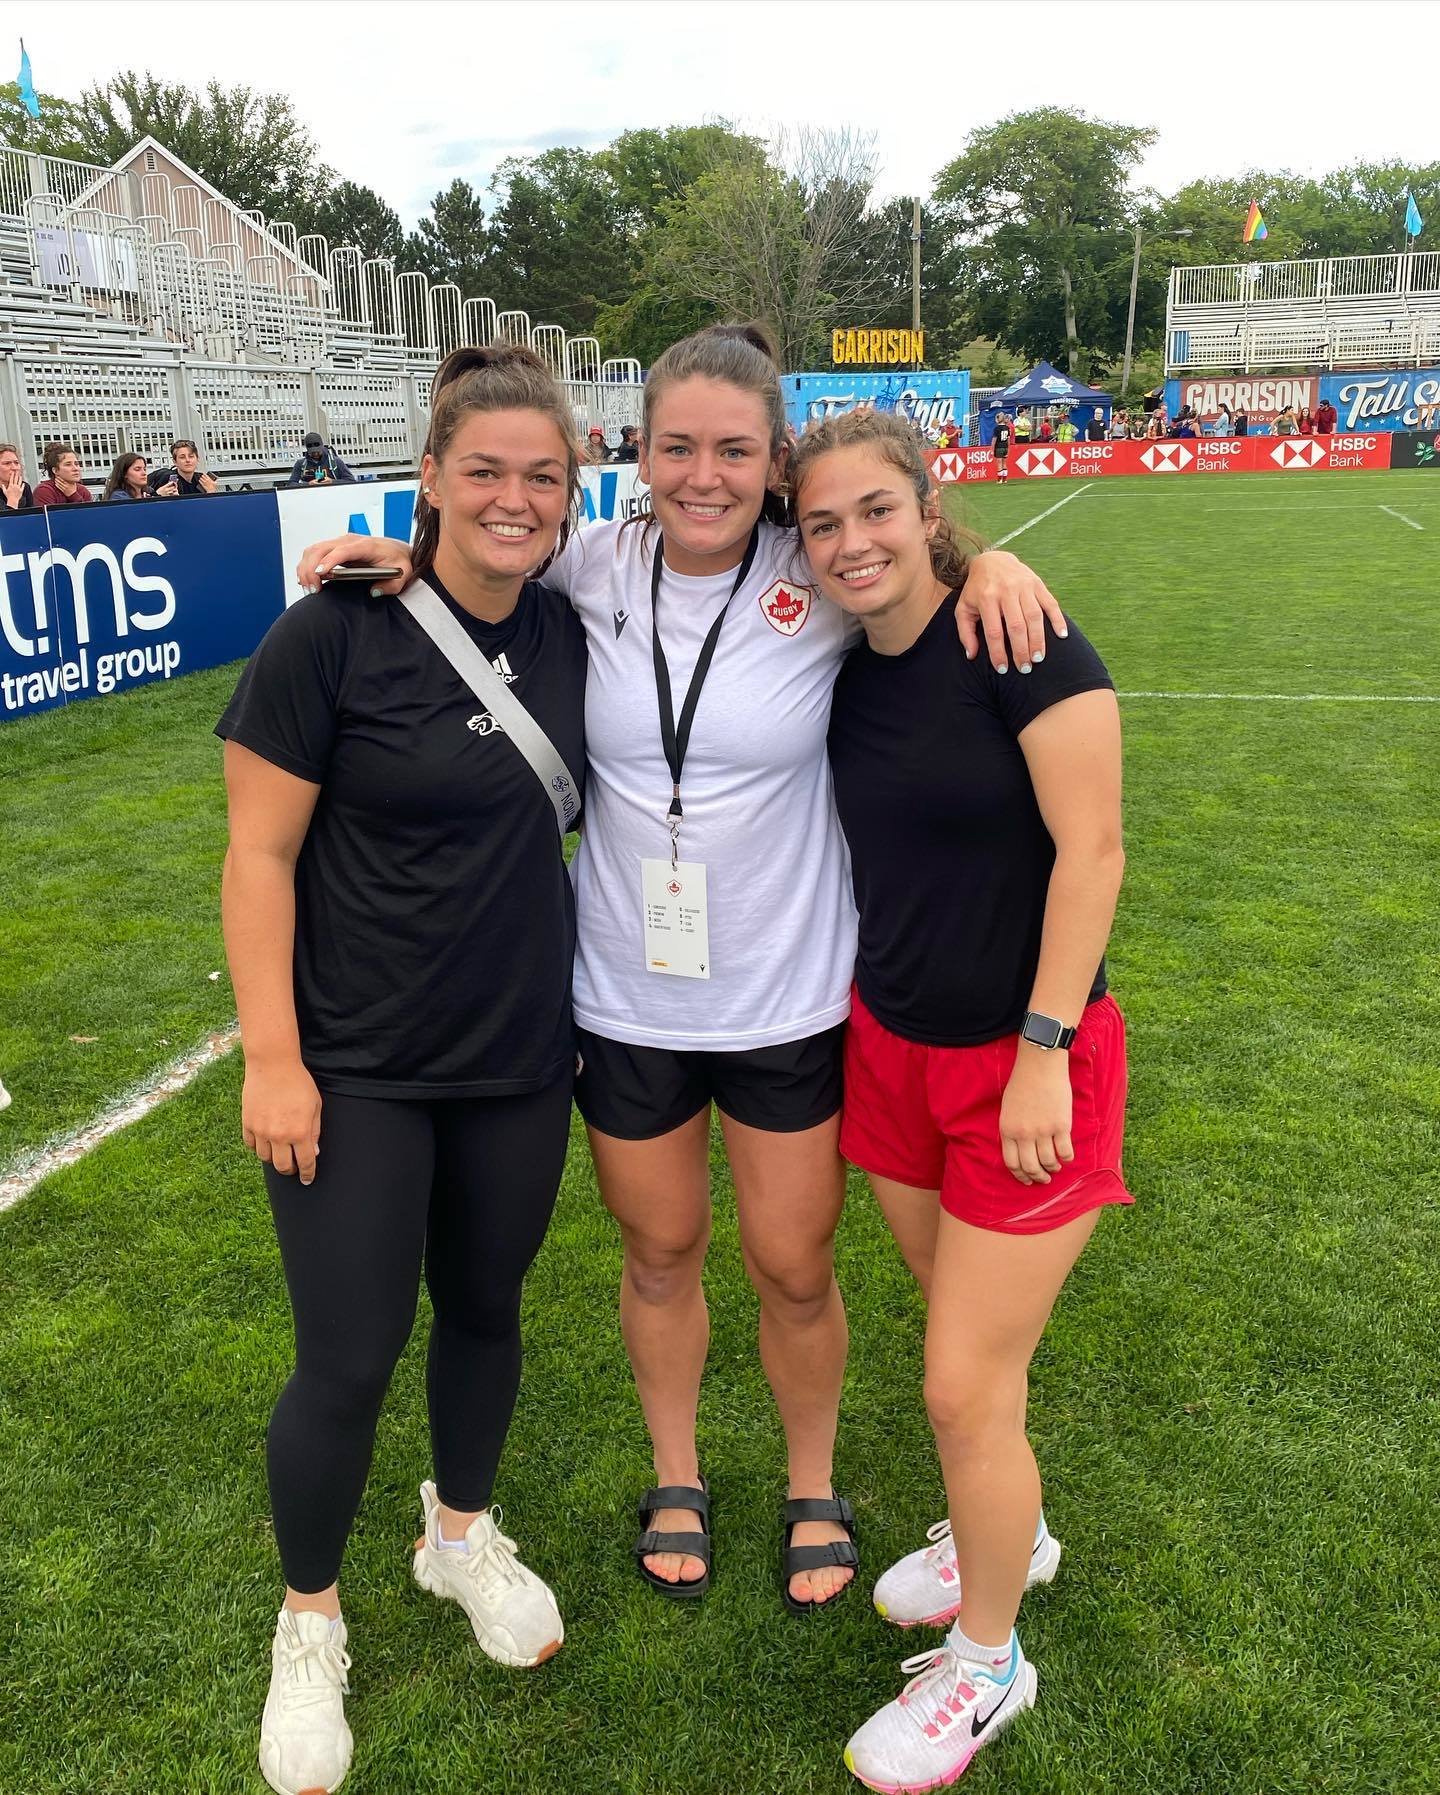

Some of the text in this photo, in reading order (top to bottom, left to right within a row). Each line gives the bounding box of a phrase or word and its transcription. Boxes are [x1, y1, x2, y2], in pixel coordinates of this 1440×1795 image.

[832, 327, 925, 364] GARRISON
[1186, 380, 1311, 416] GARRISON
[1339, 376, 1409, 428] Tall
[1197, 441, 1242, 456] HSBC
[1330, 437, 1377, 451] HSBC
[967, 450, 994, 465] HSBC
[1070, 446, 1113, 459] HSBC
[1197, 457, 1230, 470] Bank
[1330, 454, 1364, 467] Bank
[967, 466, 987, 480] Bank
[1070, 461, 1102, 475] Bank
[773, 603, 799, 616] RUGBY
[1, 640, 181, 710] travel group
